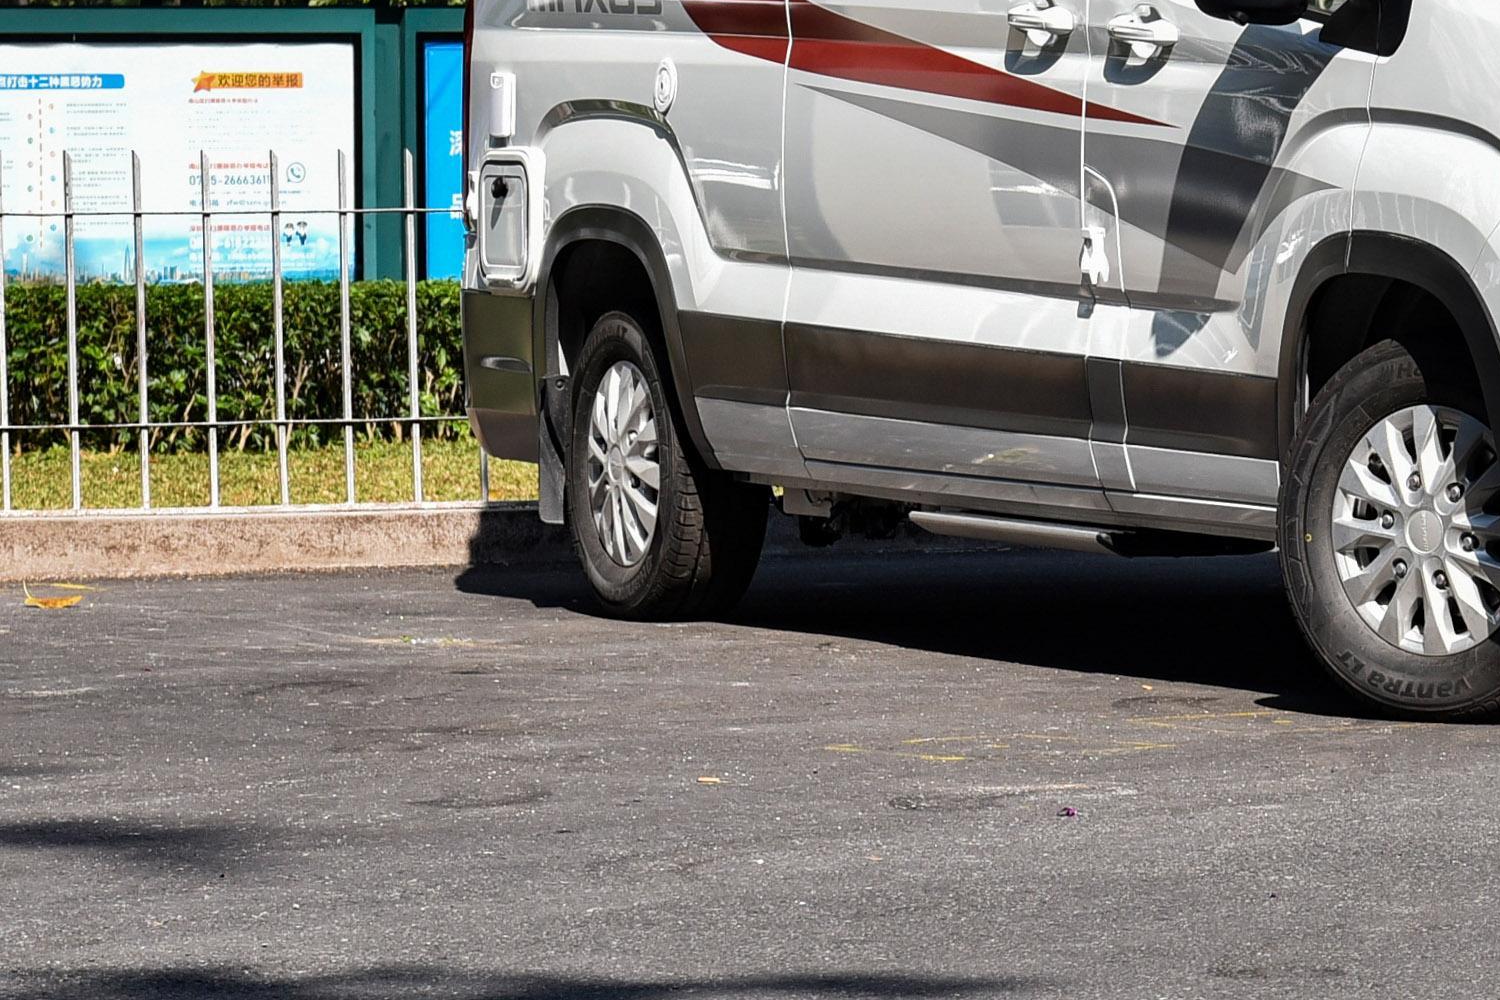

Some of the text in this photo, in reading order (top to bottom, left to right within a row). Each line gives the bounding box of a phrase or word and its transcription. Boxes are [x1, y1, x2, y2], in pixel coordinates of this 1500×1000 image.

[217, 73, 299, 88] 欢迎您的举报
